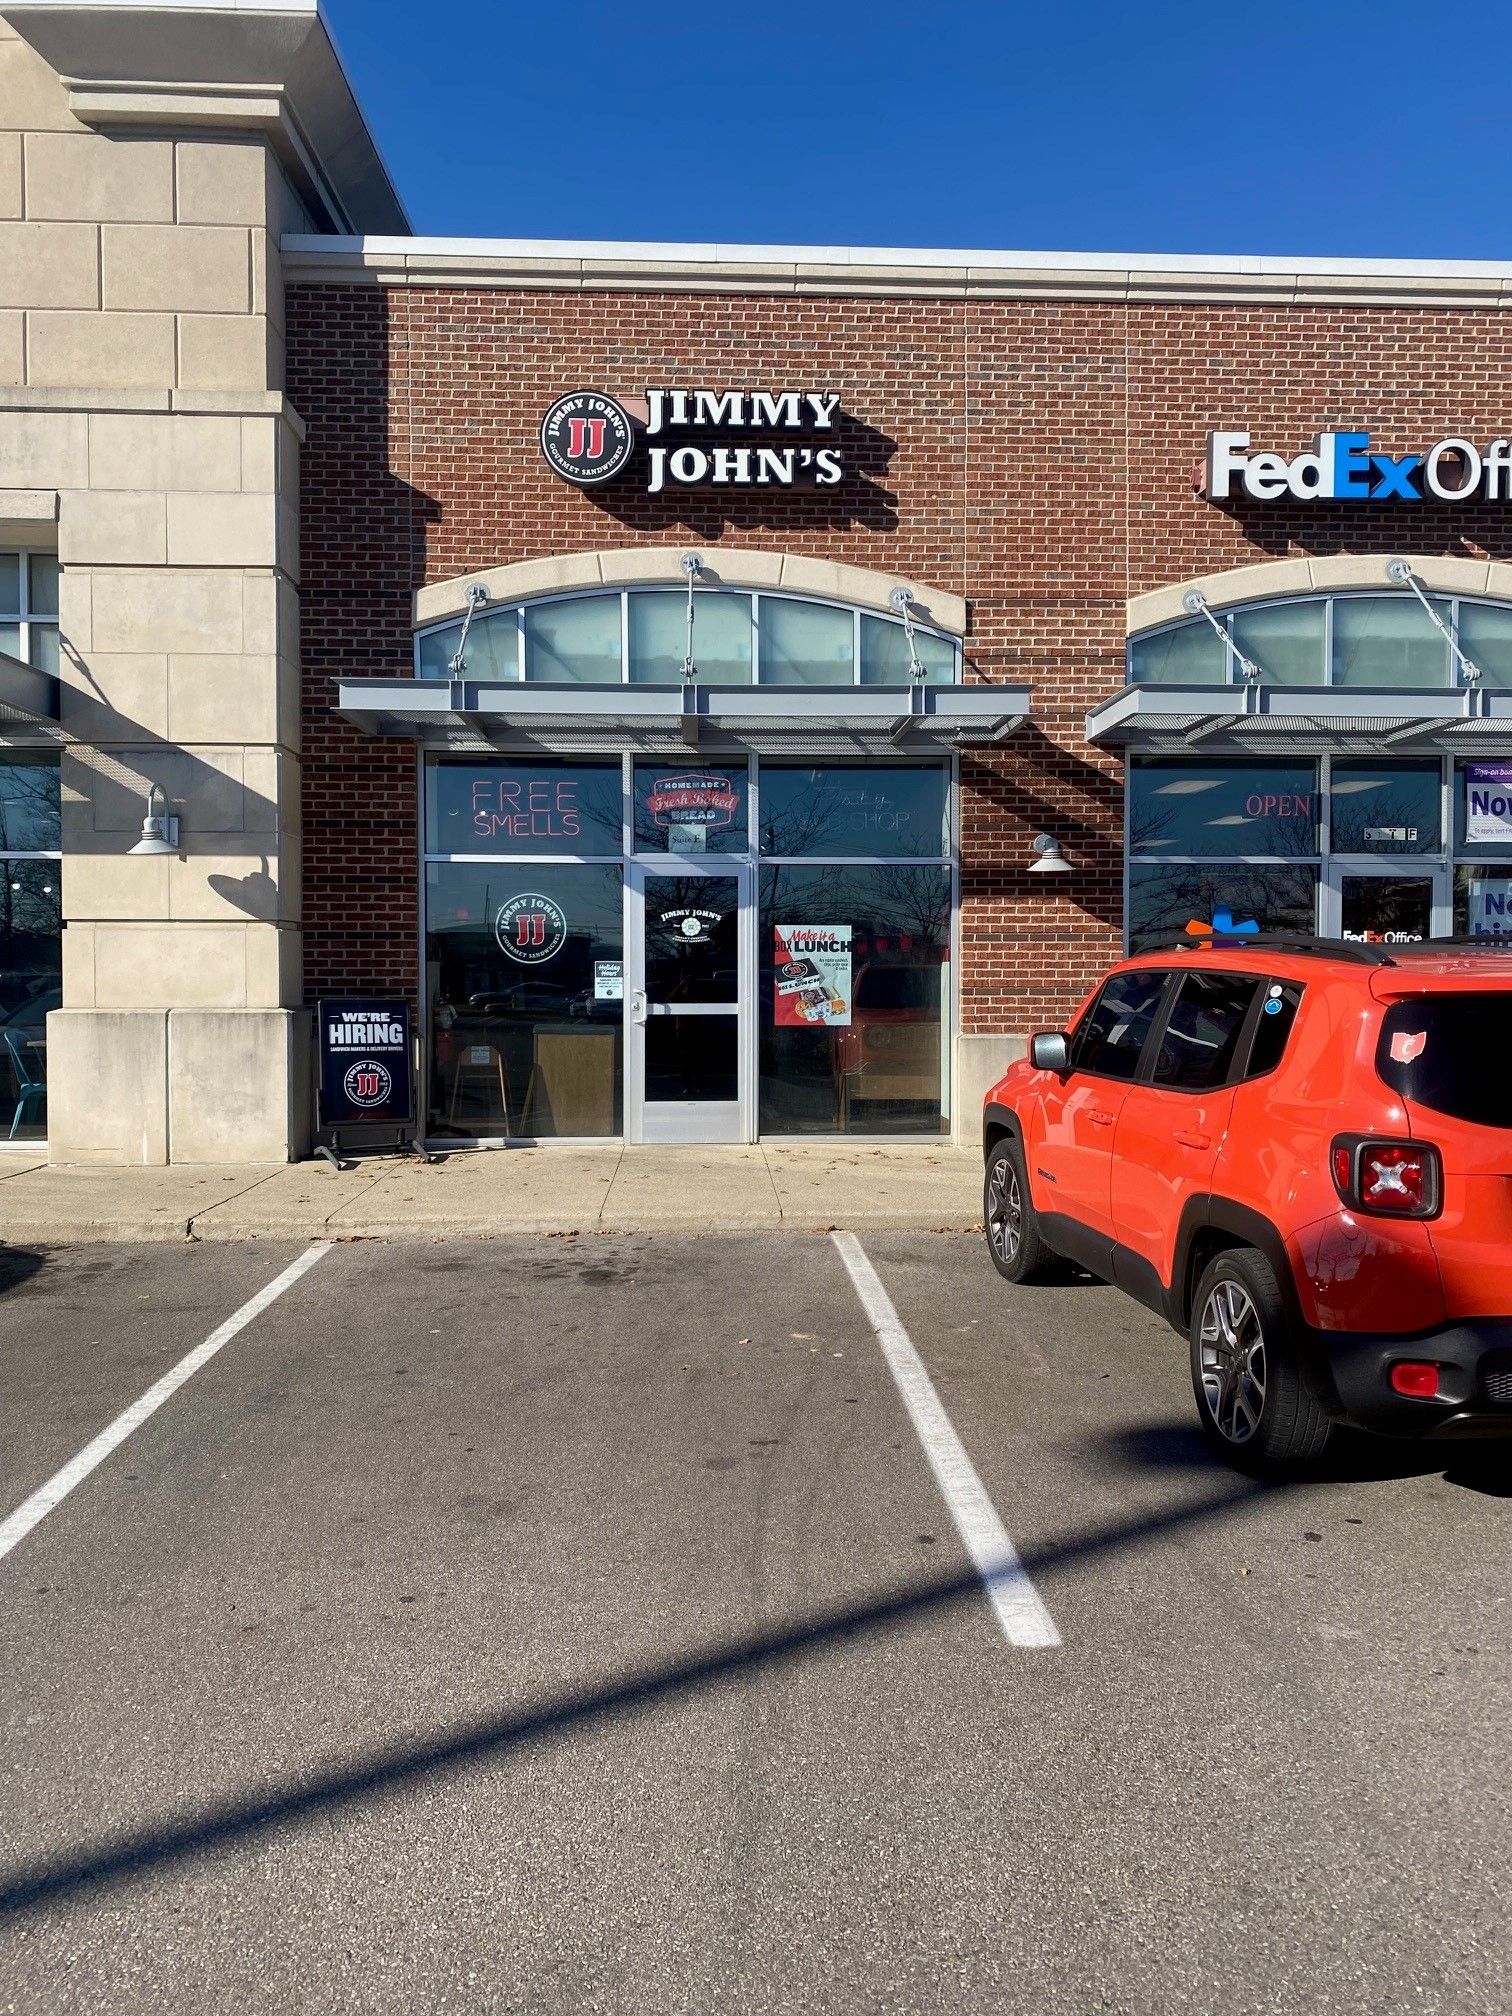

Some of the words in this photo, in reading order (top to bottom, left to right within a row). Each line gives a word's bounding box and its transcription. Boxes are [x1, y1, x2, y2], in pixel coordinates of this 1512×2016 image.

[548, 398, 584, 437] JIMMY
[587, 398, 625, 438] JOHN'S
[646, 389, 840, 434] JIMMY
[567, 418, 607, 458] JJ
[549, 443, 580, 474] GOURMET
[581, 445, 624, 476] SANDWICHES
[647, 447, 842, 492] JOHN'S
[1212, 431, 1422, 500] FedEx
[1427, 438, 1512, 500] Of
[664, 781, 719, 789] HOMEMADE
[472, 781, 578, 812] FREE
[655, 793, 688, 811] Fresh
[692, 793, 735, 809] Baked
[1246, 795, 1311, 817] OPEN
[473, 814, 580, 836] SMELLS
[671, 810, 716, 820] BREAD
[500, 898, 527, 930] JIMMY
[530, 898, 561, 928] JOHN'S
[660, 909, 690, 922] JIMMY
[692, 909, 722, 921] JOHN'S
[516, 914, 546, 945] JJ
[790, 929, 819, 942] Make
[820, 929, 828, 941] it
[828, 932, 836, 941] a
[502, 935, 527, 958] GOURMET
[528, 933, 560, 958] SANDWICHES
[794, 941, 852, 953] LUNCH
[598, 963, 620, 972] Holiday
[341, 1012, 391, 1022] WE'RE
[329, 1023, 403, 1044] HIRING
[347, 1063, 367, 1082] JIMMY
[368, 1063, 388, 1081] JOHN'S
[357, 1073, 379, 1095] JJ
